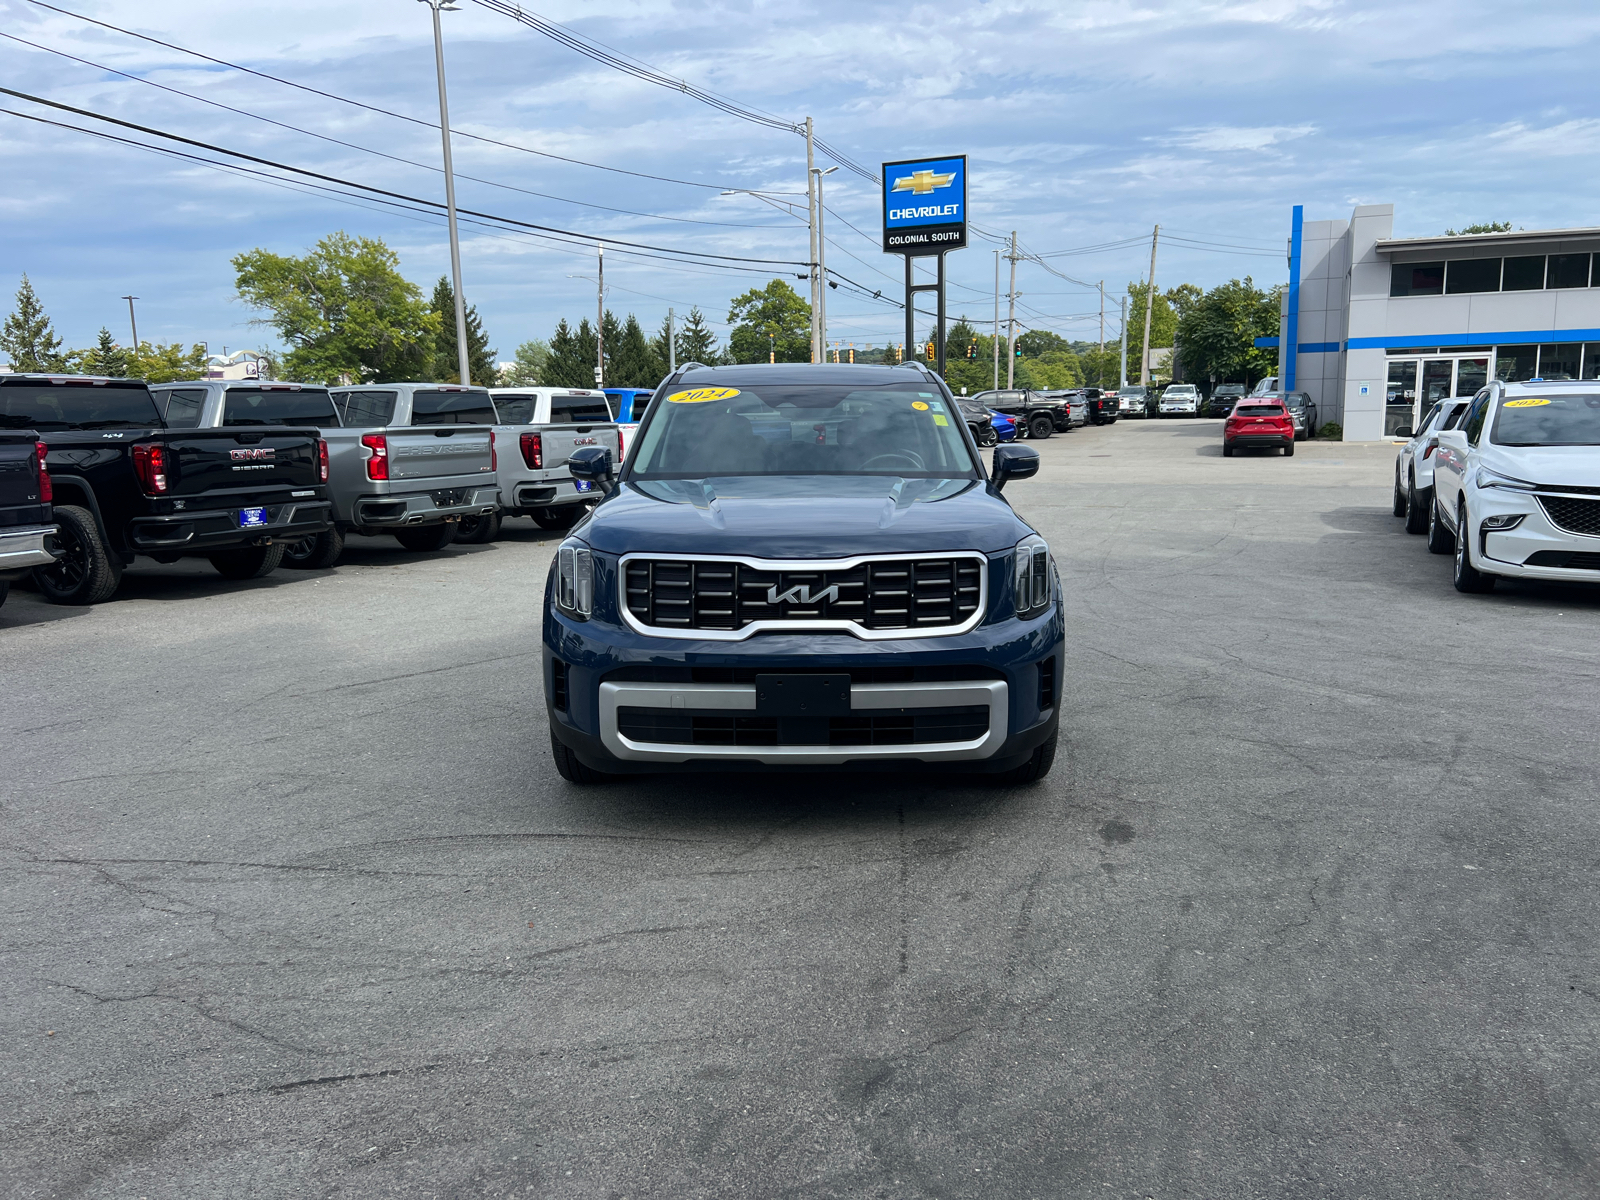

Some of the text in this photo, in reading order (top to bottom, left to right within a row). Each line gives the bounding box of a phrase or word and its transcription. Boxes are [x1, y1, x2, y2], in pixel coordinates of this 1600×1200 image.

[889, 203, 959, 220] CHEVROLET
[889, 231, 960, 245] COLONIAL SOUTH
[677, 389, 730, 401] 2024
[573, 437, 598, 446] GMC
[229, 448, 276, 461] GMC
[398, 443, 488, 456] CHEVROLET
[767, 584, 839, 604] KIA
